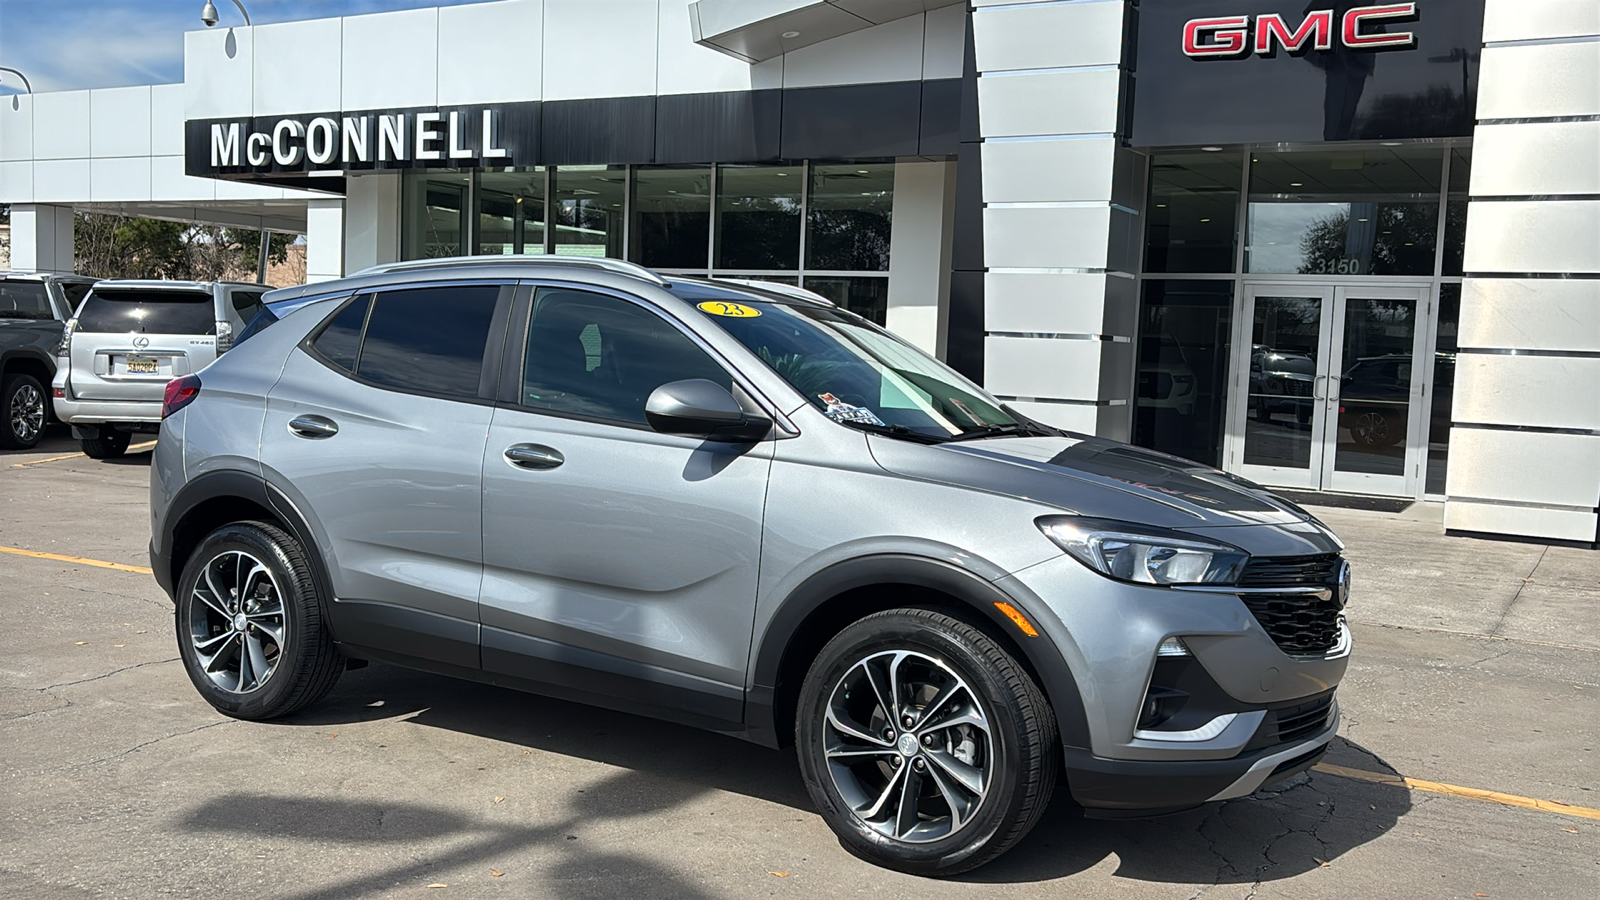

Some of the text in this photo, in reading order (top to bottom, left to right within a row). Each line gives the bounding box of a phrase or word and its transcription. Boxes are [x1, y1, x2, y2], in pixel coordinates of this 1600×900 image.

[1182, 2, 1416, 56] GMC
[211, 109, 506, 167] McCONNELL
[1316, 258, 1360, 274] 3150
[716, 302, 745, 316] 23
